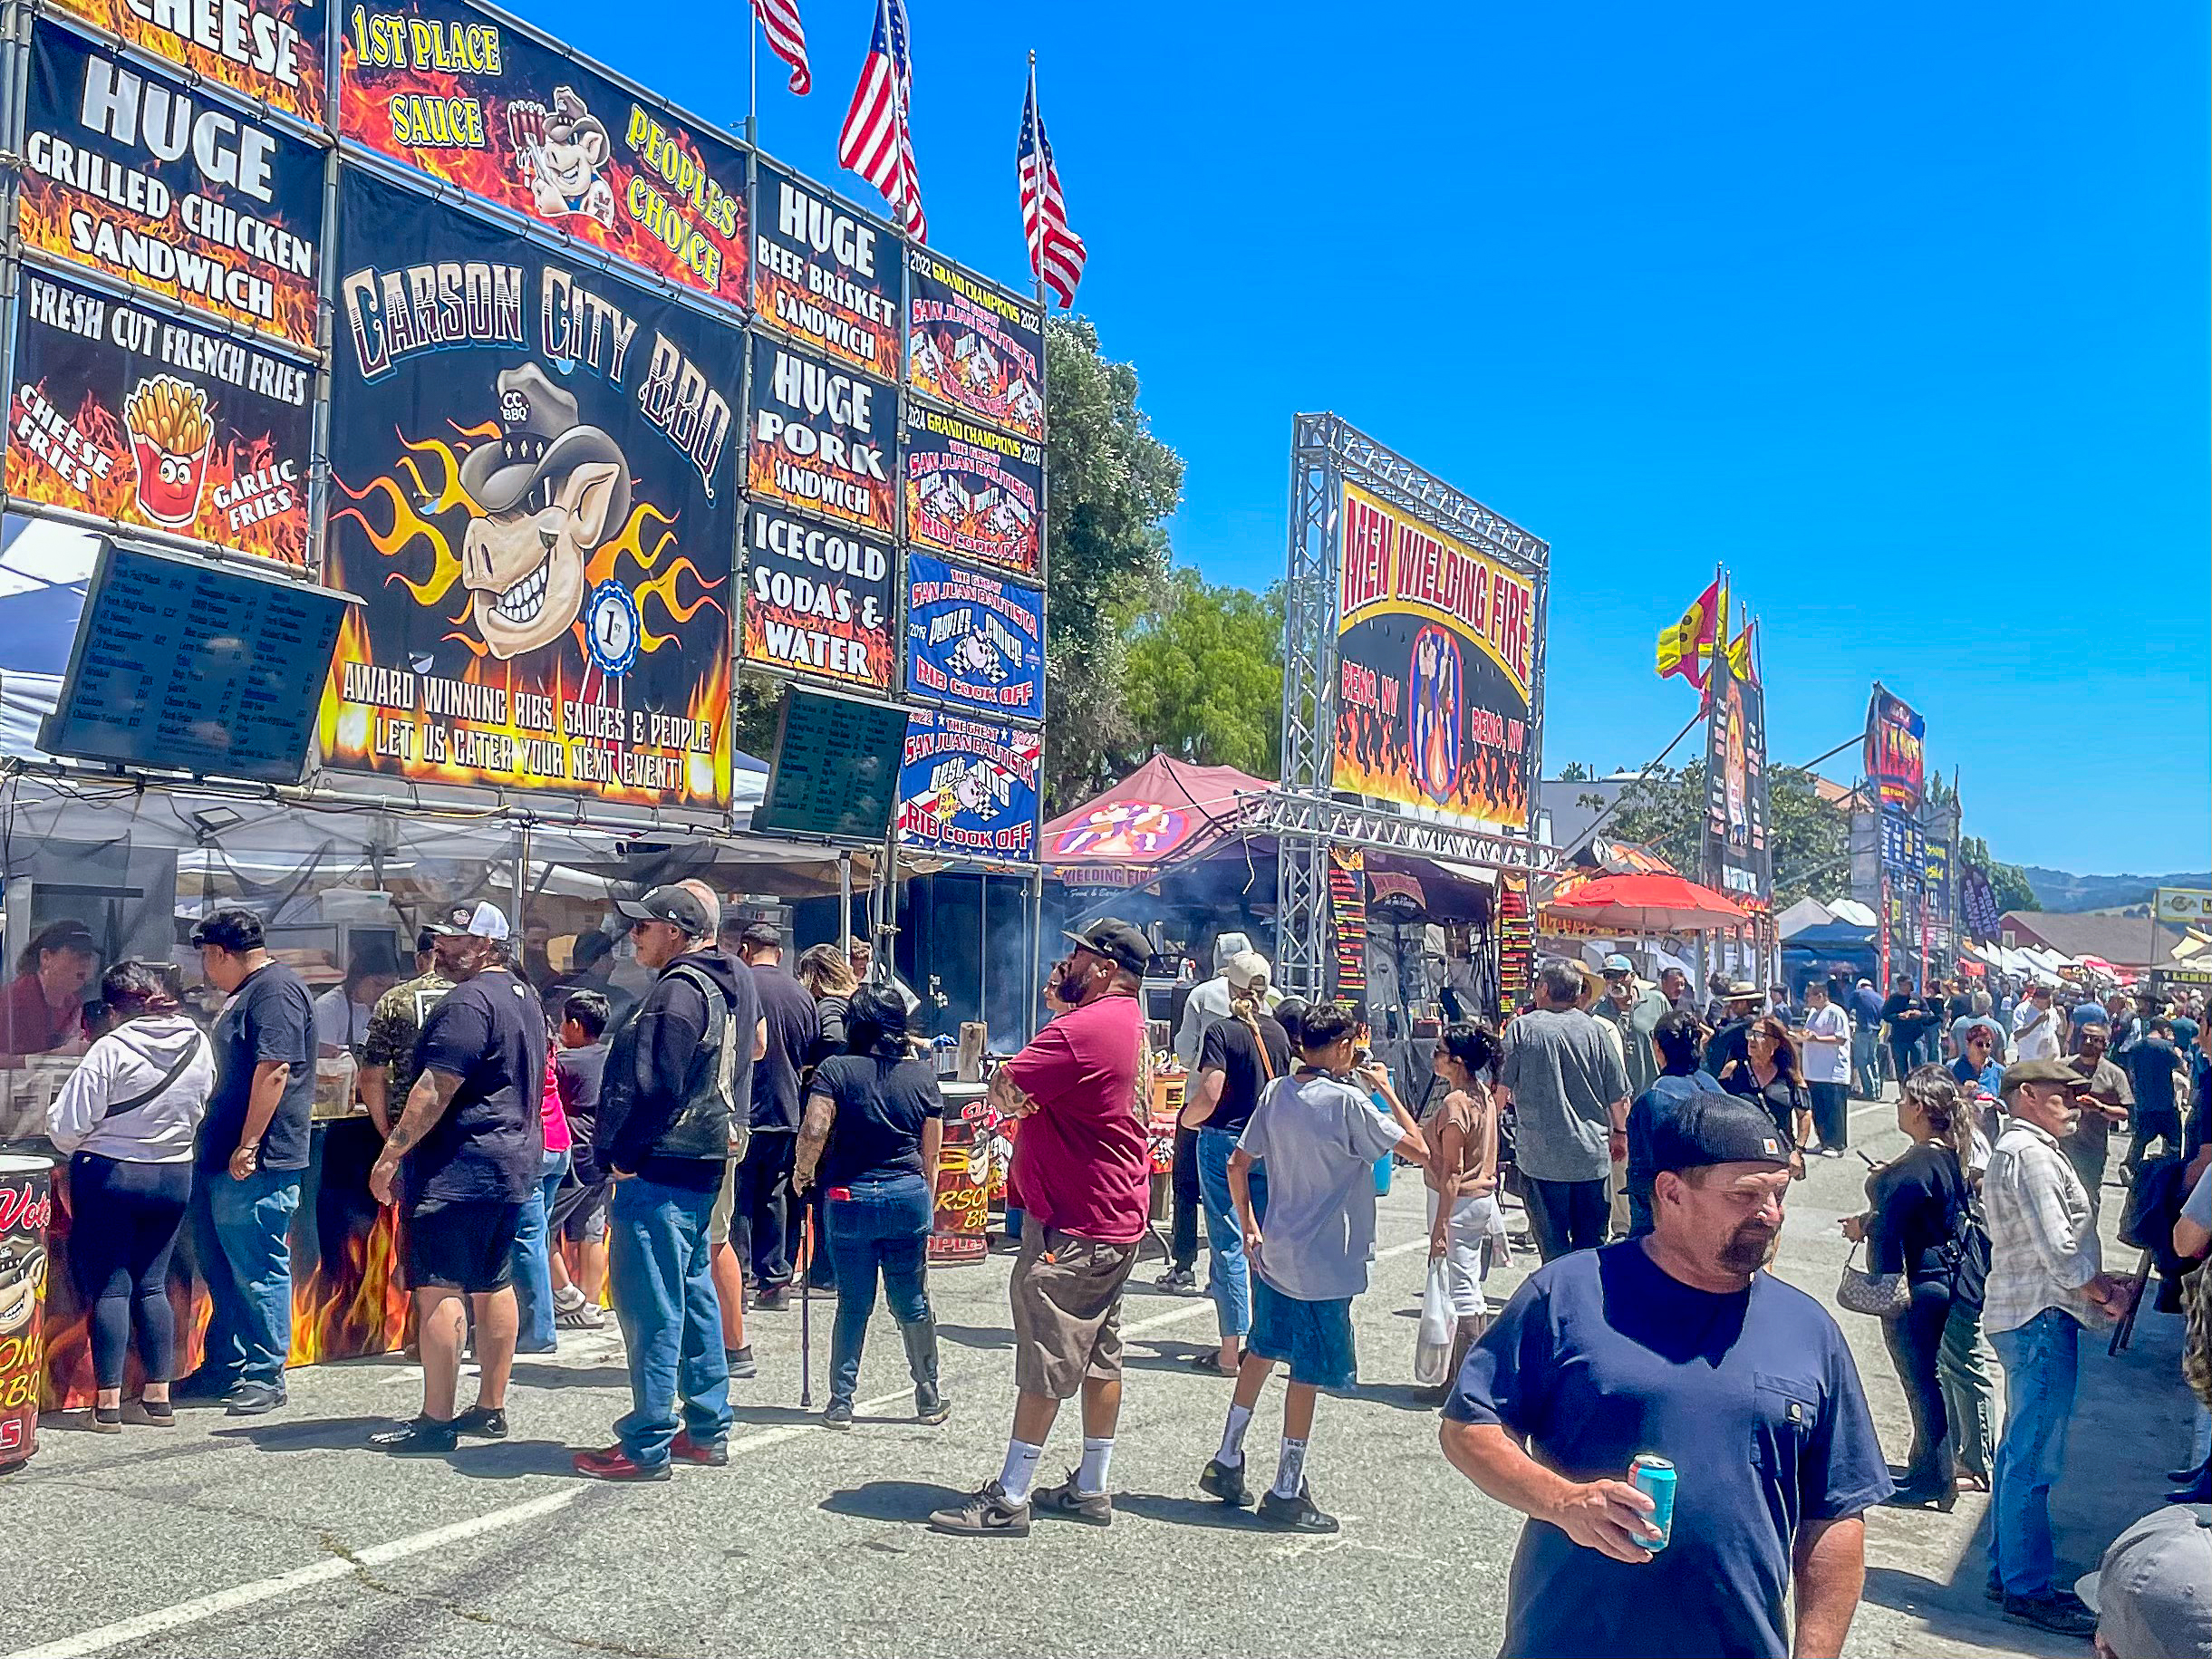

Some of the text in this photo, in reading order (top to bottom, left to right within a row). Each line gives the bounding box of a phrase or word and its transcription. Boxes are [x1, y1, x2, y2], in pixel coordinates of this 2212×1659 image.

[351, 4, 503, 75] 1ST PLACE
[81, 53, 276, 204] HUGE
[389, 93, 485, 149] SAUCE
[27, 130, 314, 278] GRILLED CHICKEN
[625, 102, 739, 240] PEOPLES
[626, 175, 723, 290] CHOICE
[778, 180, 876, 279] HUGE
[70, 210, 274, 321] SANDWICH
[757, 235, 896, 328] BEEF BRISKET
[910, 250, 1041, 335] 2022 GRAND CHAMPIONS 2022
[29, 276, 307, 407] FRESH CUT FRENCH FRIES
[775, 290, 875, 362] SANDWICH
[913, 298, 943, 324] SAN
[943, 302, 976, 330] JUAN
[976, 317, 1038, 381] BAUTISTA
[343, 261, 732, 500] CARSON CITY BBQ
[502, 406, 527, 421] BBQ
[503, 391, 523, 409] CC
[774, 351, 874, 434] HUGE
[17, 413, 92, 493] FRIES
[19, 384, 114, 480] CHEESE
[757, 409, 887, 482] PORK
[907, 404, 1042, 467] 2024 GRAND CHAMPIONS 2024
[212, 458, 298, 509] GARLIC
[228, 488, 293, 532] FRIES
[774, 459, 871, 517] SANDWICH
[909, 452, 939, 479] SAN
[939, 452, 975, 473] JUAN
[975, 459, 1038, 516] BAUTISTA
[754, 511, 886, 583] ICECOLD
[921, 506, 1029, 561] RIB COOK OFF
[754, 564, 884, 630] SODAS &
[912, 581, 1039, 642] SAN JUAN BAUTISTA
[951, 568, 971, 585] THE
[1341, 493, 1531, 690] MEN WIELDING FIRE
[764, 619, 872, 679] WATER
[928, 608, 1023, 670] PEOPLES CHOICE
[343, 661, 414, 709] AWARD
[422, 676, 507, 725] WINNING
[514, 691, 556, 735] RIBS,
[564, 700, 626, 742] SAUCES
[650, 713, 712, 753] PEOPLE
[916, 654, 1034, 707] RIB COOK OFF
[1341, 659, 1400, 719] RENO, NV
[375, 718, 684, 792] LET US CATER YOUR NEXT EVENT!
[905, 732, 1036, 792] SAN JUAN BAUTISTA
[945, 717, 967, 733] THE
[966, 720, 999, 742] GREAT
[1471, 706, 1525, 759] RENO, NV
[906, 798, 1033, 850] RIB COOK OFF
